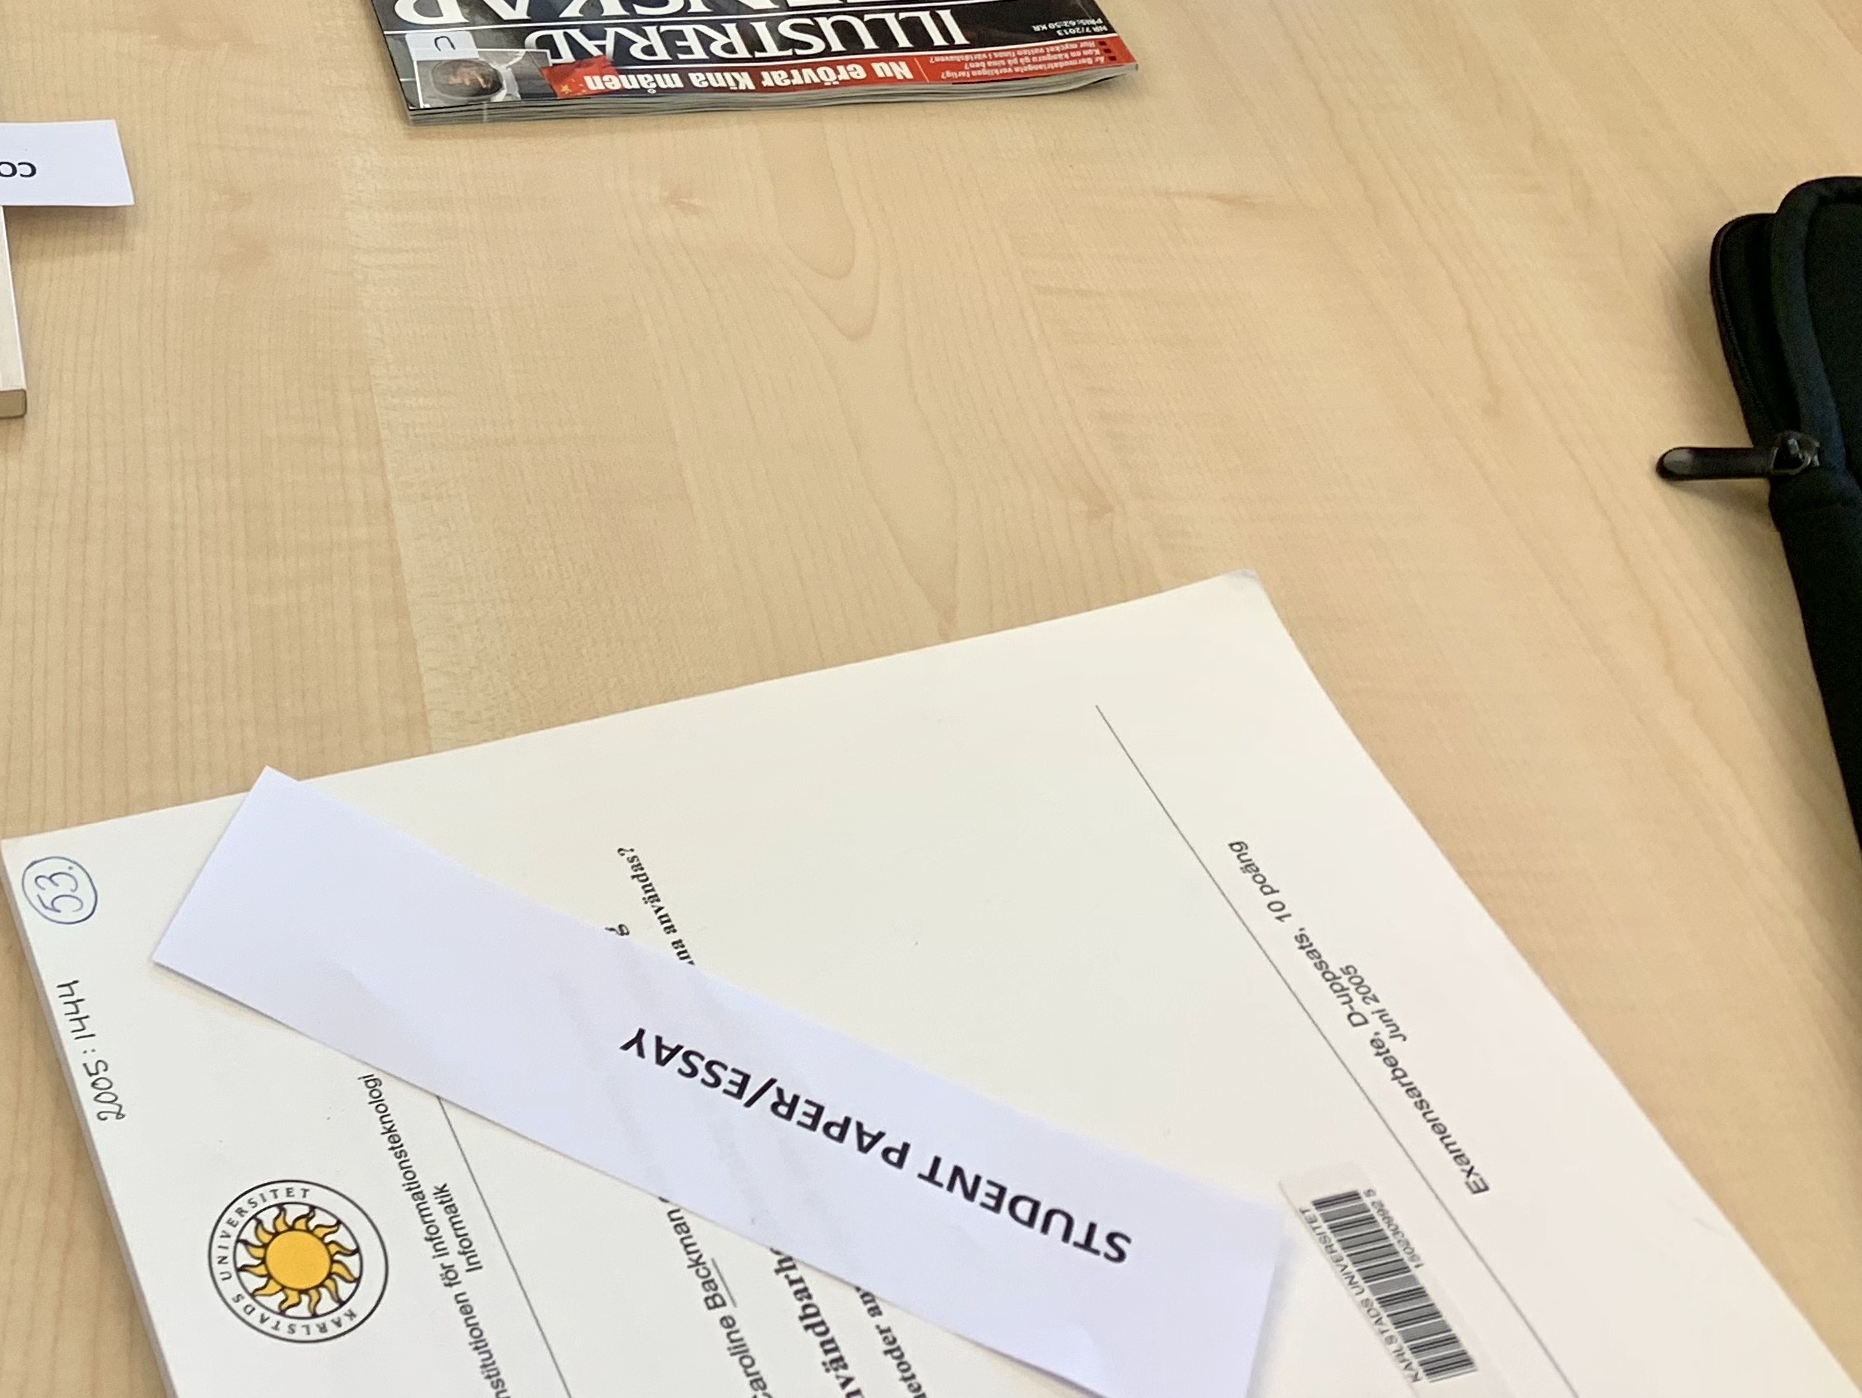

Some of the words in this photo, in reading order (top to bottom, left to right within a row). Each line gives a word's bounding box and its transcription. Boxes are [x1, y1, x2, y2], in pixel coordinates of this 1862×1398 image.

[525, 9, 970, 64] ILLUSTRERAD
[1032, 24, 1047, 32] KR
[1091, 25, 1108, 33] NR
[995, 50, 1016, 58] finns
[1018, 47, 1044, 56] vatten
[1031, 52, 1068, 64] känguru
[1046, 42, 1078, 53] mycket
[1079, 40, 1096, 48] Hur
[762, 64, 867, 87] erövrar
[878, 62, 914, 80] Nu
[940, 70, 970, 79] farlig?
[964, 61, 985, 70] ben?
[971, 67, 1013, 77] verkligen
[987, 59, 1005, 67] sina
[584, 72, 683, 94] månen
[692, 69, 755, 92] Kina
[1228, 839, 1280, 898] poäng
[616, 846, 679, 936] användas?
[1267, 899, 1294, 925] 10
[1293, 925, 1368, 1030] D-uppsats,
[1340, 963, 1380, 1006] 2005
[1371, 1006, 1408, 1044] Juni
[619, 1027, 912, 1172] PAPER/ESSAY
[1370, 1030, 1490, 1197] Examensarbete,
[918, 1155, 1132, 1264] STUDENT
[217, 1187, 312, 1282] UNIVERSITET
[432, 1182, 483, 1274] Informatik
[666, 1206, 729, 1310] Backman
[1300, 1205, 1365, 1297] UNIVERSITET
[443, 1261, 466, 1289] för
[231, 1291, 358, 1336] KARLSTADS
[454, 1290, 513, 1398] nstitutionen
[1360, 1295, 1422, 1385] KARLSTADS
